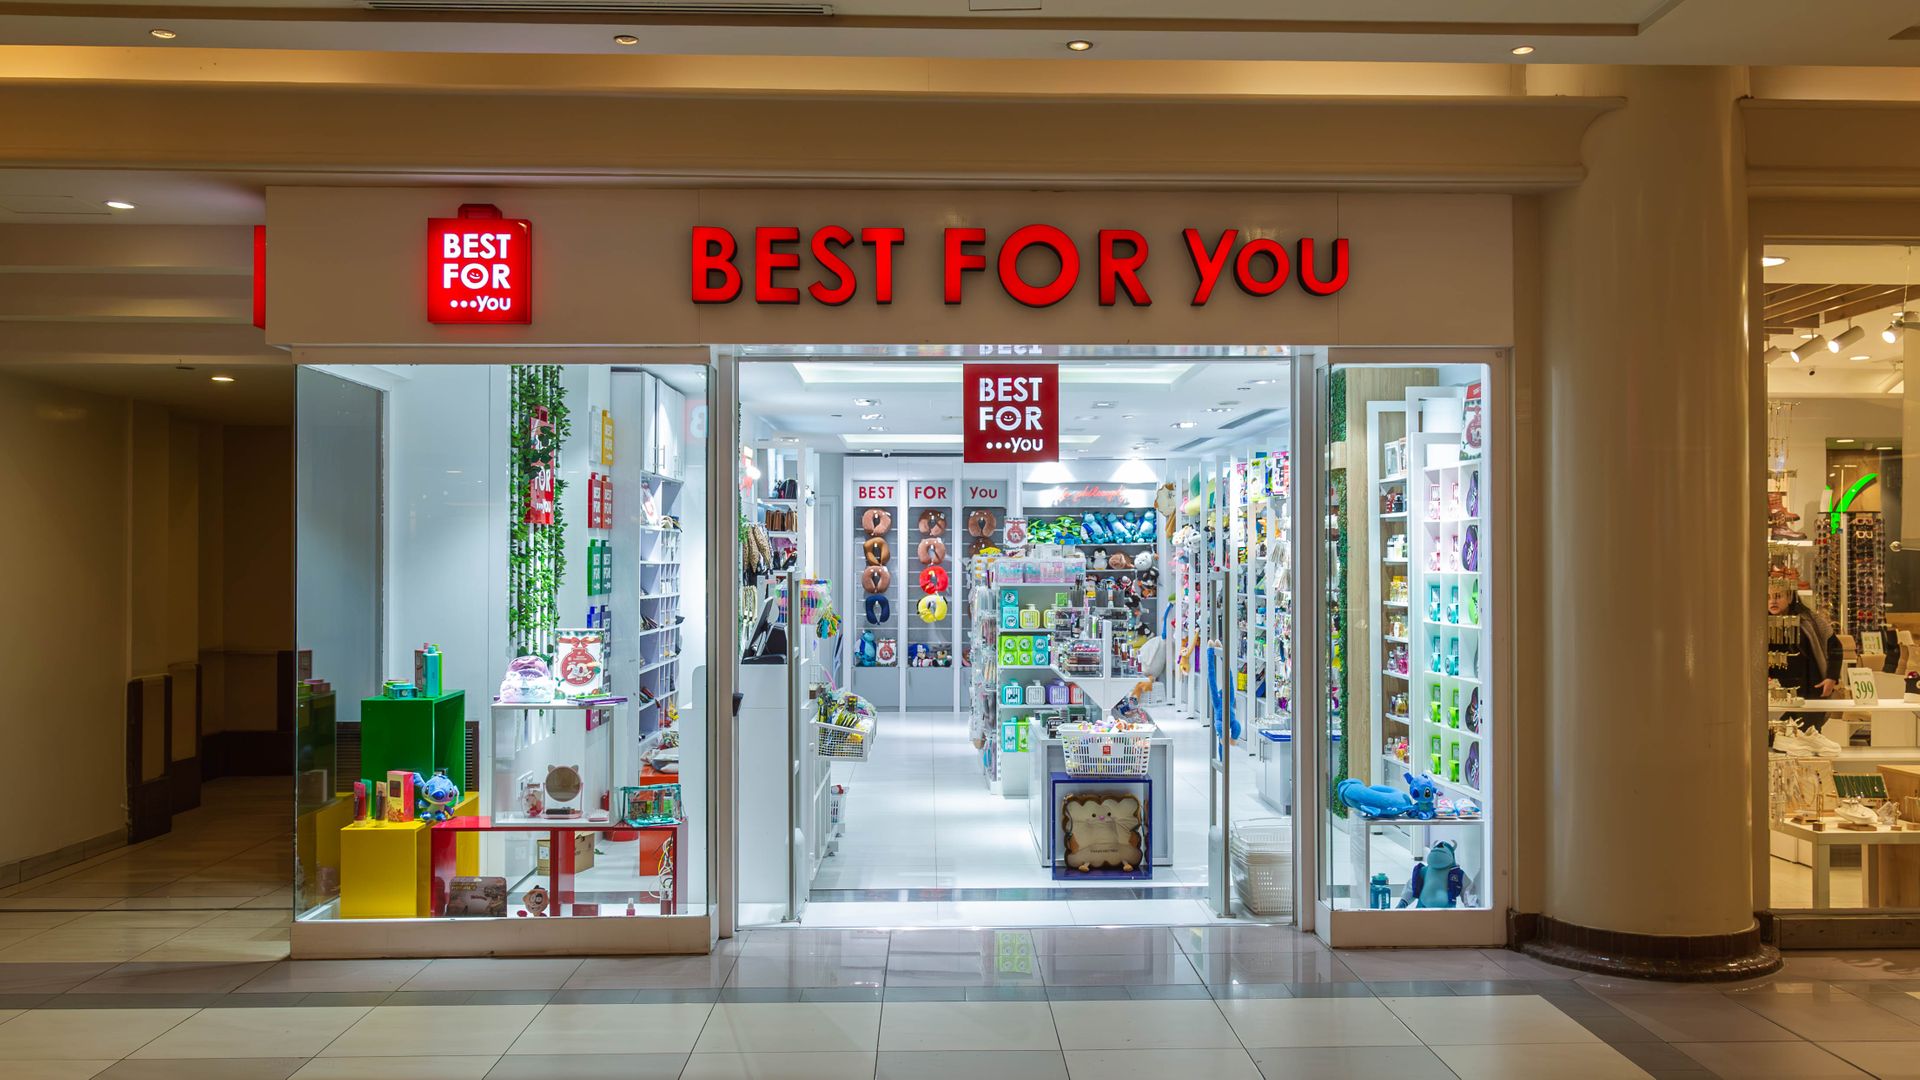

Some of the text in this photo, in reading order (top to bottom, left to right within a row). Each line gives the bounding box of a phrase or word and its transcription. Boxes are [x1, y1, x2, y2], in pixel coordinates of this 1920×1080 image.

[443, 233, 511, 259] BEST
[443, 263, 511, 290] FOR
[692, 225, 905, 306] BEST
[944, 223, 1152, 308] FOR
[979, 377, 1043, 402] BEST
[979, 406, 1043, 431] FOR
[858, 486, 894, 499] BEST
[914, 485, 947, 499] FOR
[1854, 681, 1874, 699] 399
